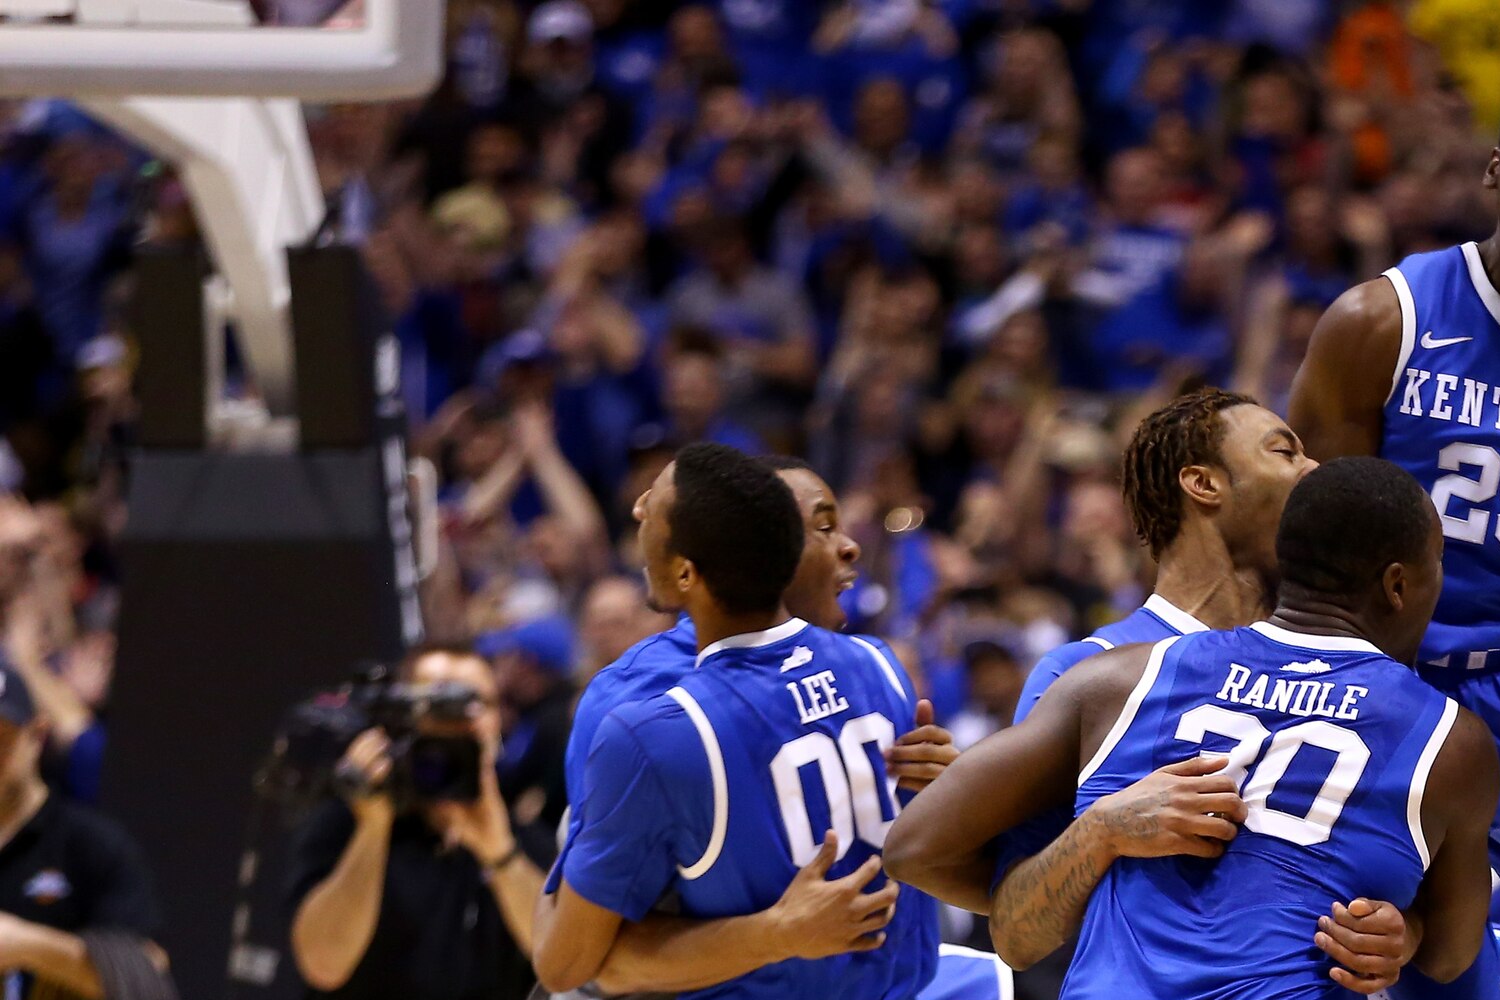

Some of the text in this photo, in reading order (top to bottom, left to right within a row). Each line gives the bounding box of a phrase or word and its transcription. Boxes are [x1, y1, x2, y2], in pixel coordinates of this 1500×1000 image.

[786, 669, 849, 725] LEE
[1215, 662, 1369, 721] RANDLE
[769, 711, 902, 869] 00
[1173, 703, 1372, 847] 30
